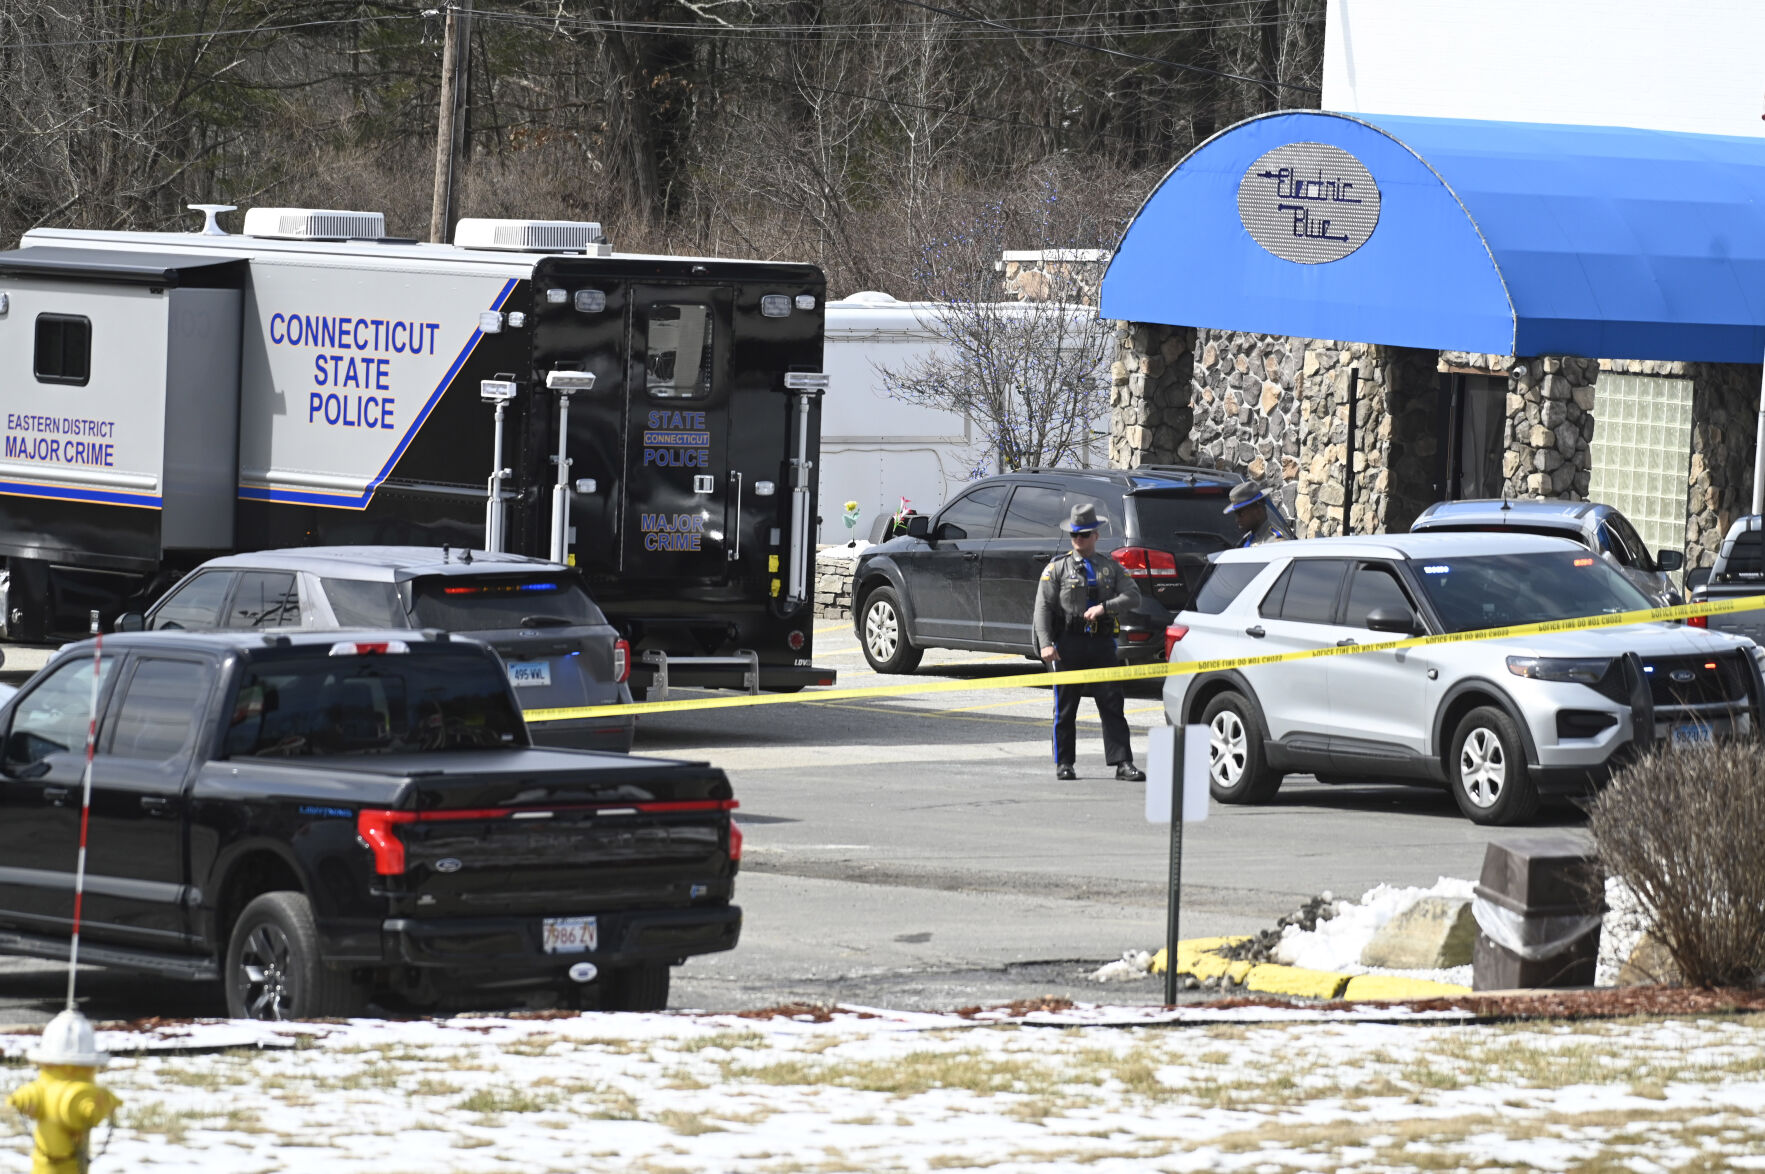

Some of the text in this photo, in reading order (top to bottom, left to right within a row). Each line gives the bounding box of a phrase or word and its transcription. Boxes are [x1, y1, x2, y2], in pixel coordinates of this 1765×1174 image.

[1290, 205, 1345, 240] Blue
[270, 312, 440, 355] CONNECTICUT
[314, 354, 390, 390] STATE
[309, 392, 395, 429] POLICE
[648, 410, 706, 429] STATE
[8, 414, 115, 438] EASTERN DISTRICT
[5, 435, 114, 466] MAJOR CRIME
[645, 434, 708, 444] CONNECTICUT
[644, 449, 709, 467] POLICE
[641, 514, 704, 532] MAJOR
[644, 533, 702, 551] CRIME
